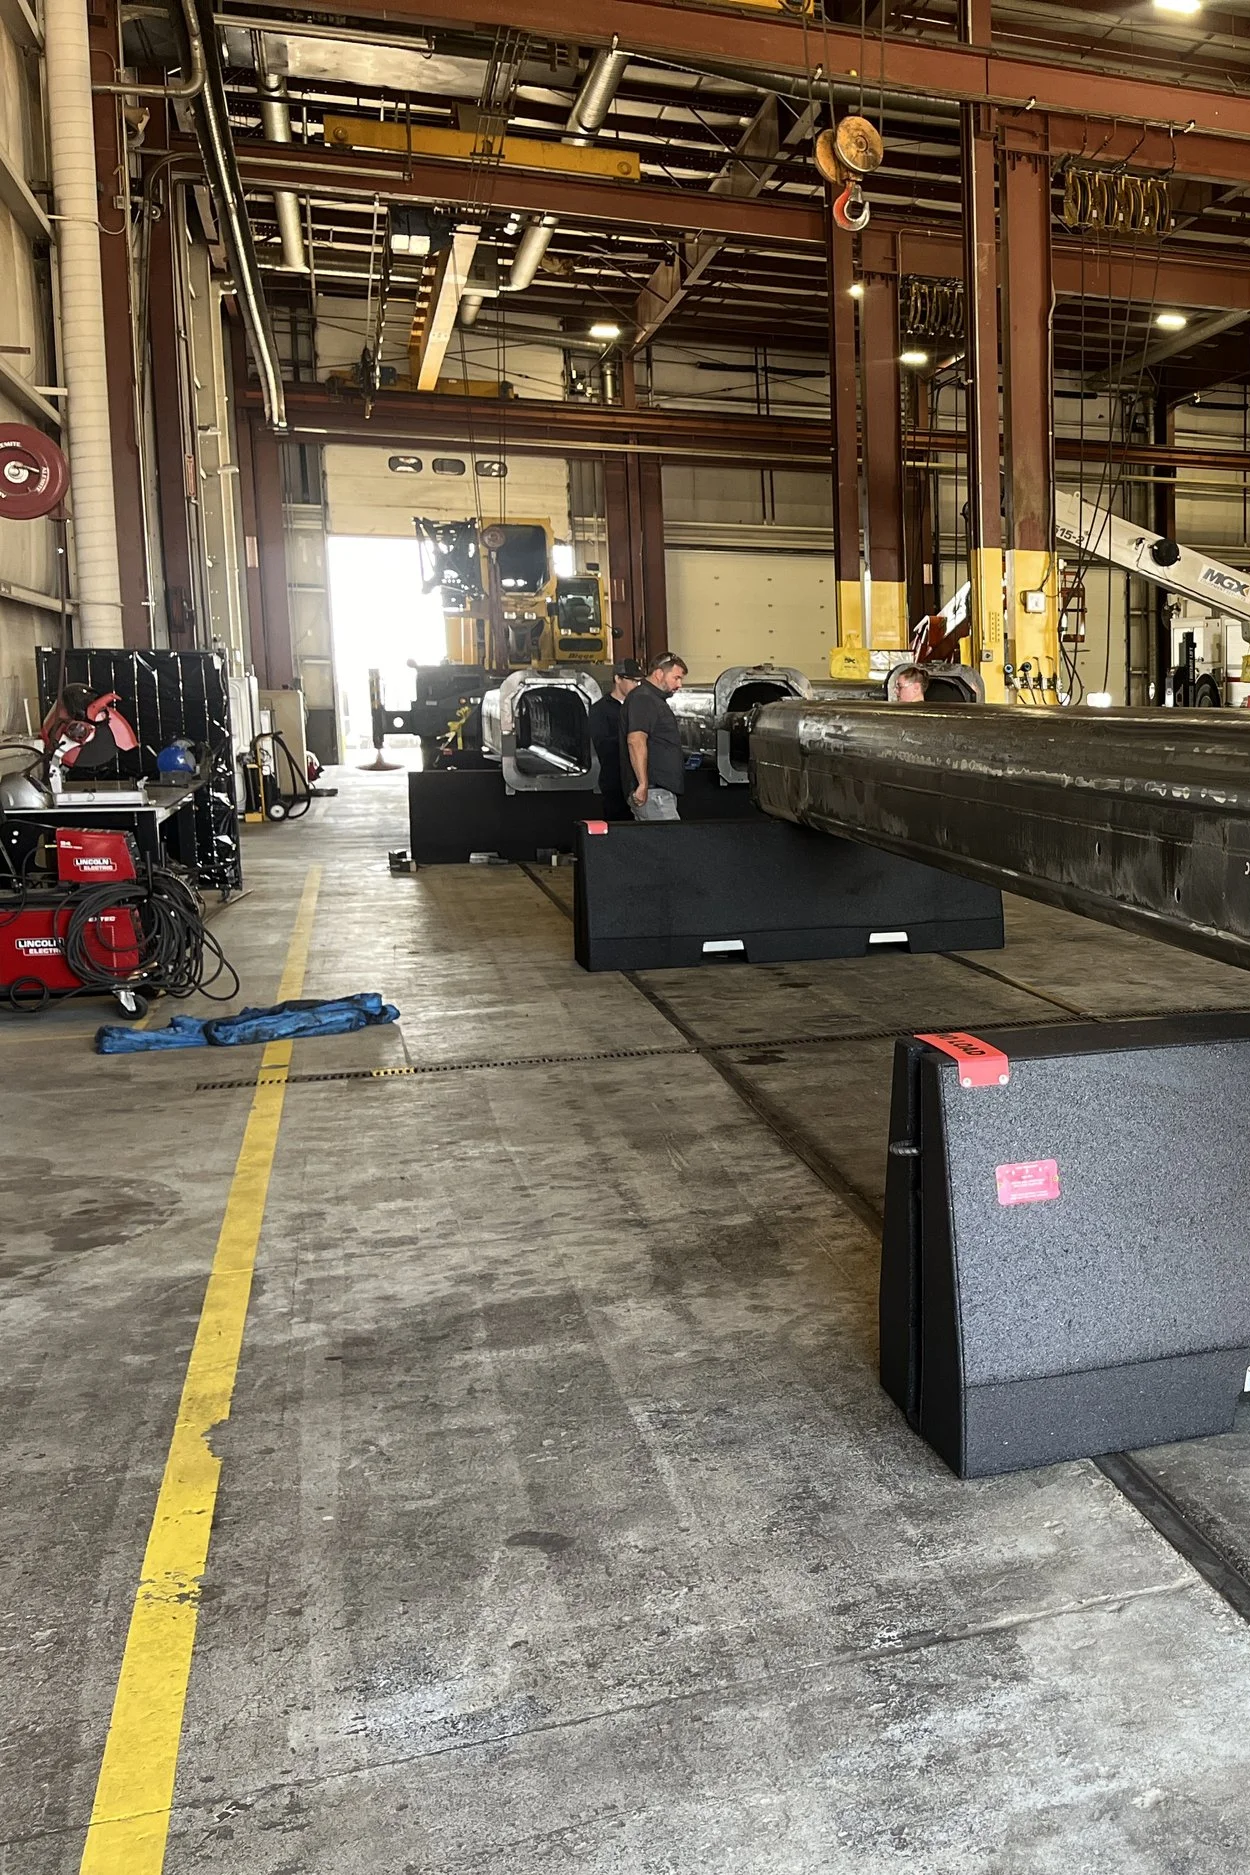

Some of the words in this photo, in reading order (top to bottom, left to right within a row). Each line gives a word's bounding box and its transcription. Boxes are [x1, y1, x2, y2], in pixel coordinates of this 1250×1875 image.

[1202, 567, 1249, 597] MGX
[75, 858, 110, 866] LINCOLN
[946, 1040, 987, 1056] LOAD
